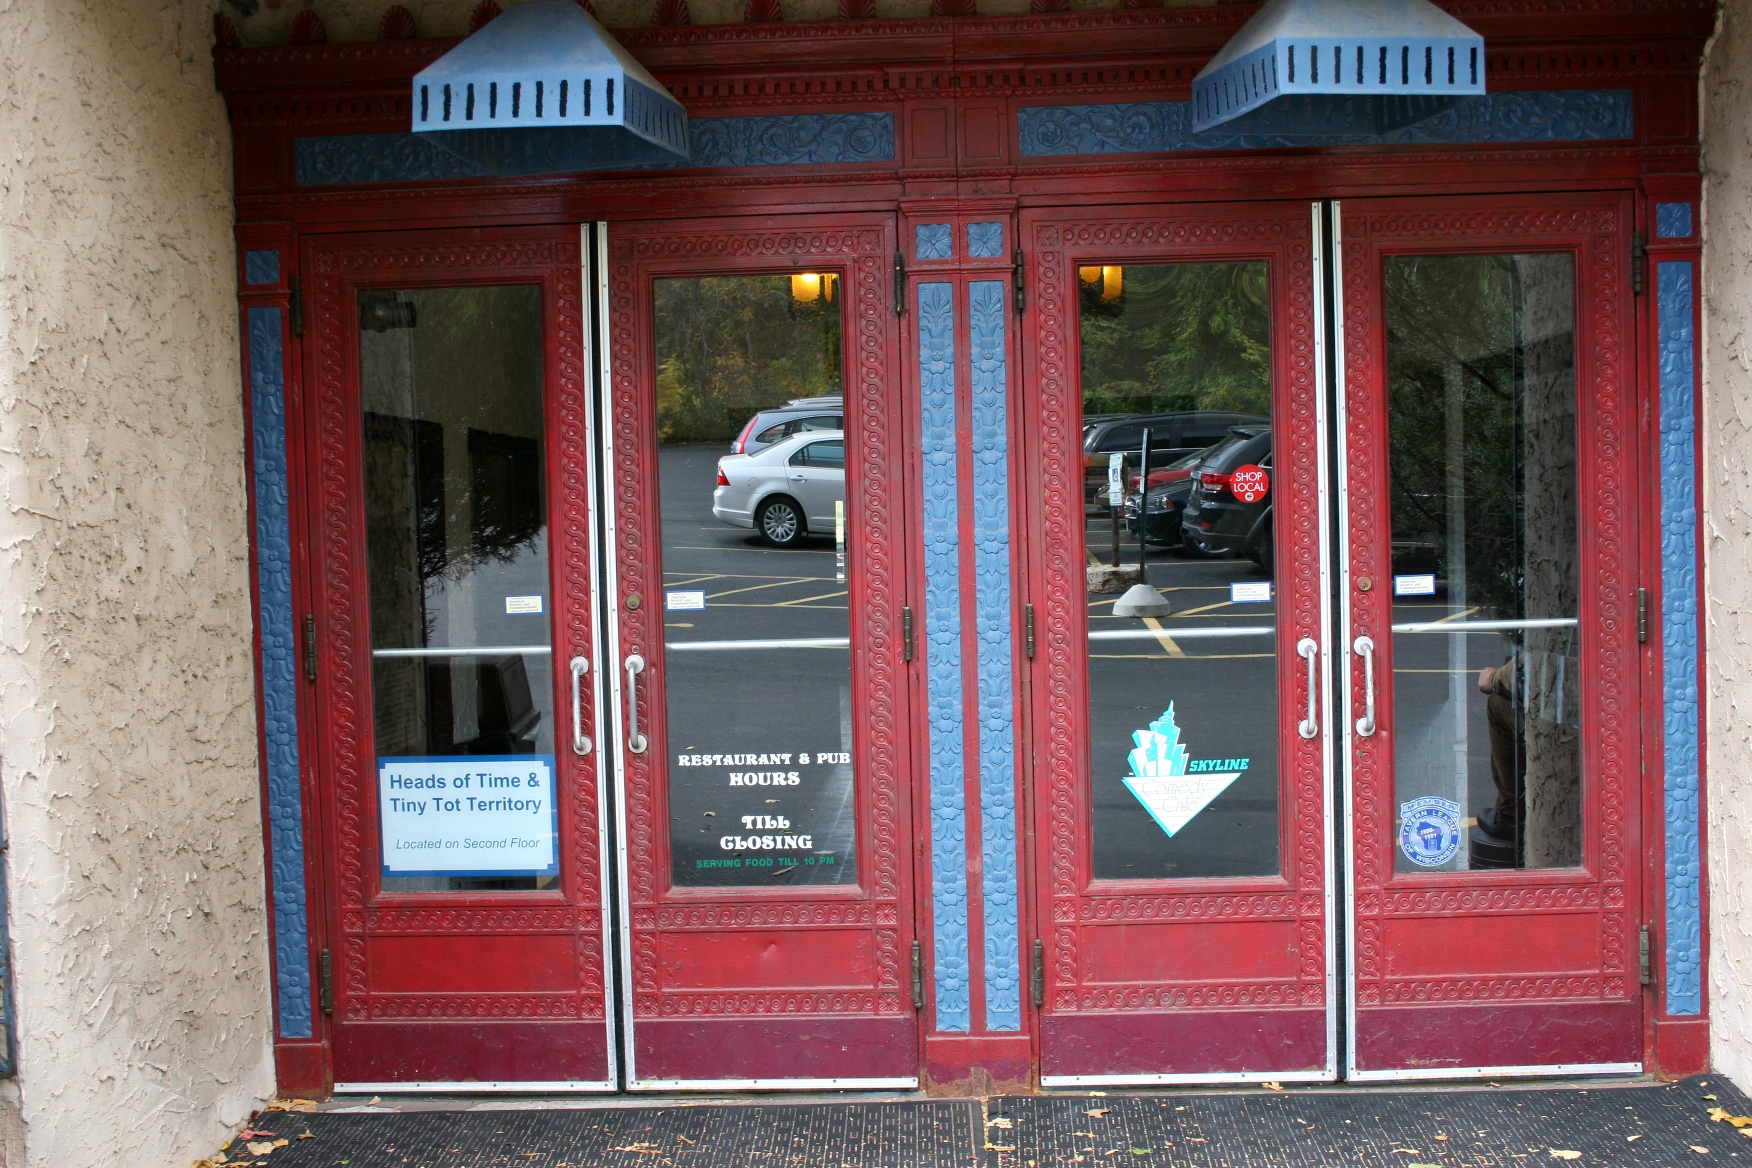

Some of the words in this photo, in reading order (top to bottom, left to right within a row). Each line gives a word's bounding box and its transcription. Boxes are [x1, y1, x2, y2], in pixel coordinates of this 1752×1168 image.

[1235, 471, 1263, 482] SHOP
[1233, 482, 1265, 493] LOCAL
[678, 753, 792, 767] RESTAURANT
[798, 753, 810, 765] &
[816, 752, 851, 765] PUB
[1188, 758, 1250, 772] SKYLINE
[390, 773, 447, 789] Heads
[453, 773, 471, 788] of
[476, 773, 521, 788] Time
[527, 772, 541, 788] &
[729, 771, 801, 786] HOURS
[1141, 776, 1210, 799] Comedy
[390, 798, 427, 815] Tiny
[432, 797, 461, 812] Tot
[466, 796, 542, 814] Territory
[1407, 799, 1454, 810] MEMBER
[741, 815, 791, 829] TILL
[1403, 810, 1428, 836] TAVERN
[1432, 809, 1458, 836] LEAGUE
[396, 838, 443, 850] Located
[445, 840, 459, 849] on
[463, 838, 507, 849] Second
[510, 837, 541, 848] Floor
[720, 835, 813, 850] CLOSING
[1404, 843, 1415, 853] OF
[1415, 843, 1456, 863] WISCONSIN
[696, 859, 741, 869] SERVING
[745, 858, 774, 867] FOOD
[778, 857, 799, 866] TILL
[803, 857, 815, 865] 10
[819, 856, 835, 865] PM
